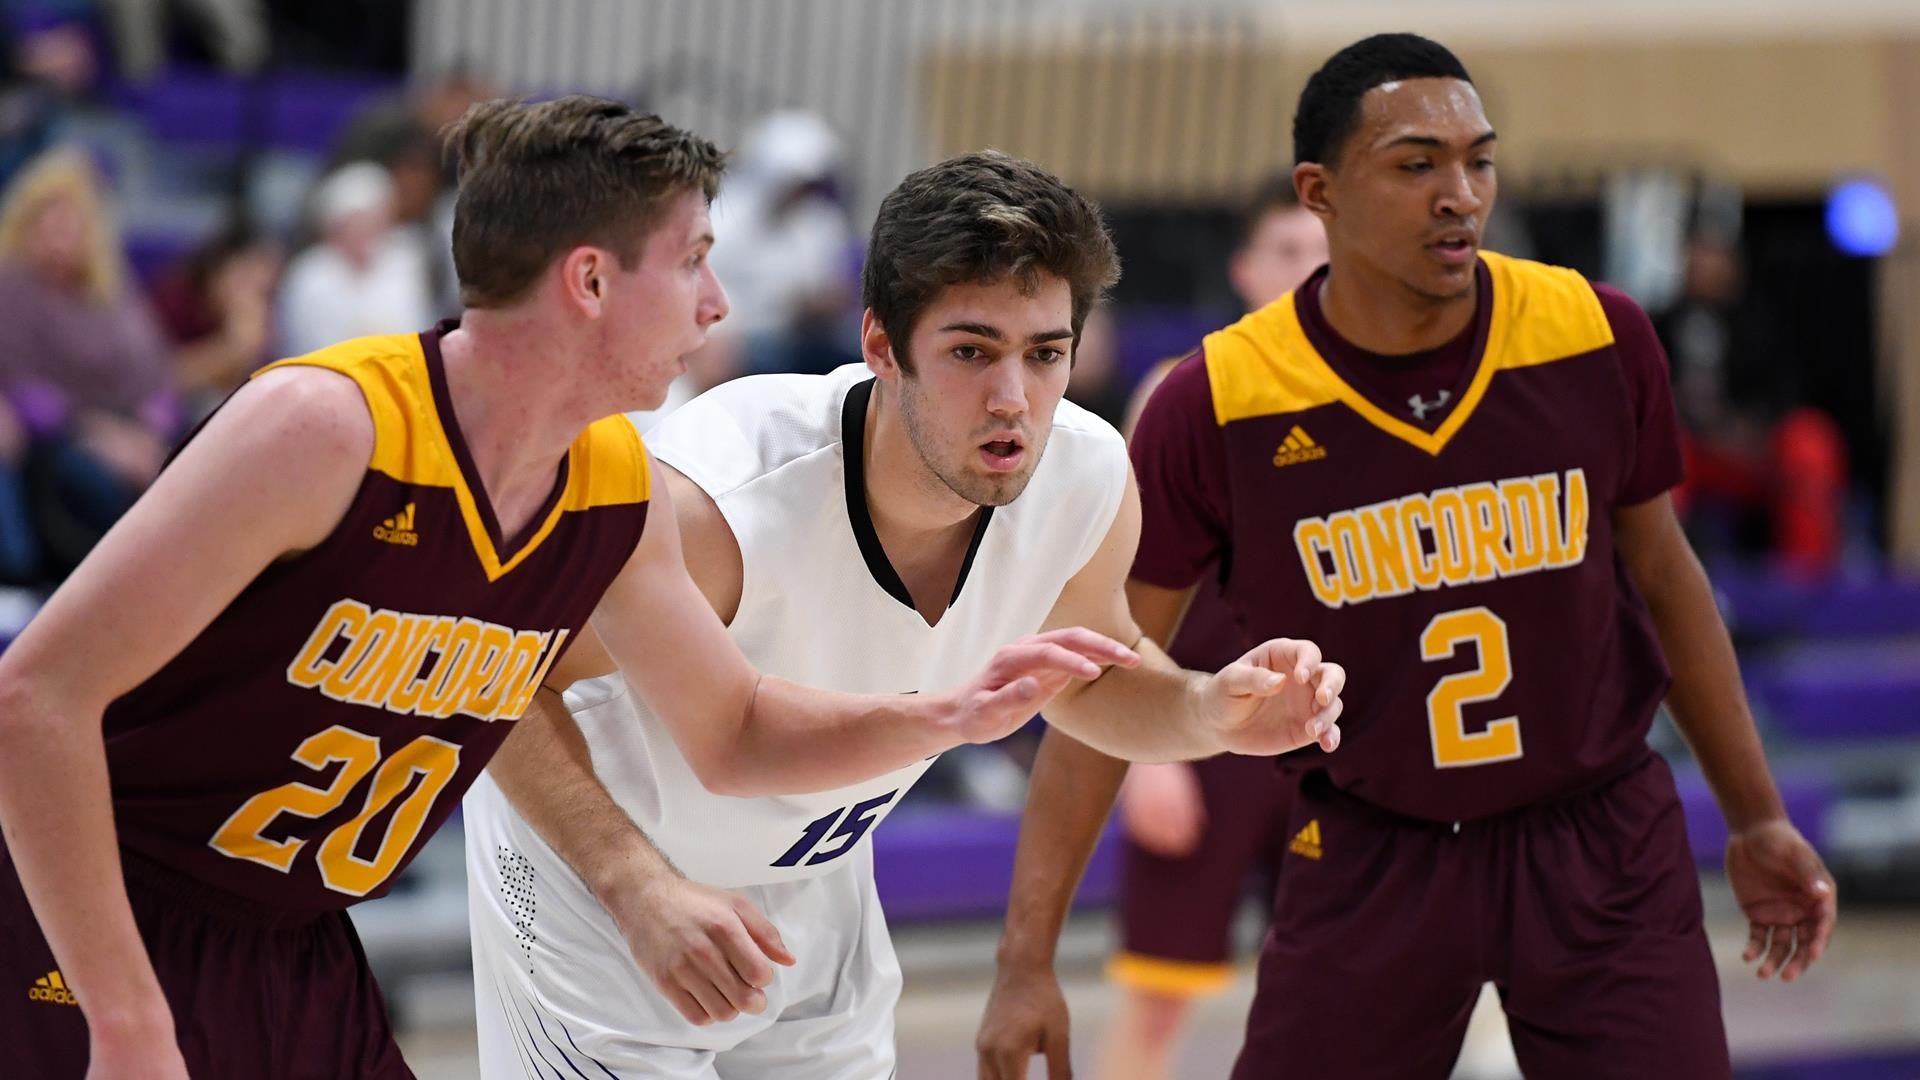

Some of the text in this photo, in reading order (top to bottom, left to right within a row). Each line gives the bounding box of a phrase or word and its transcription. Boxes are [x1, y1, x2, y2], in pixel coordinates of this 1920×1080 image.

[373, 526, 418, 546] adidas
[1293, 468, 1590, 609] CONCORDIA
[1420, 606, 1524, 769] 2
[207, 724, 462, 897] 20
[768, 787, 899, 868] 15
[29, 987, 79, 1005] adida
